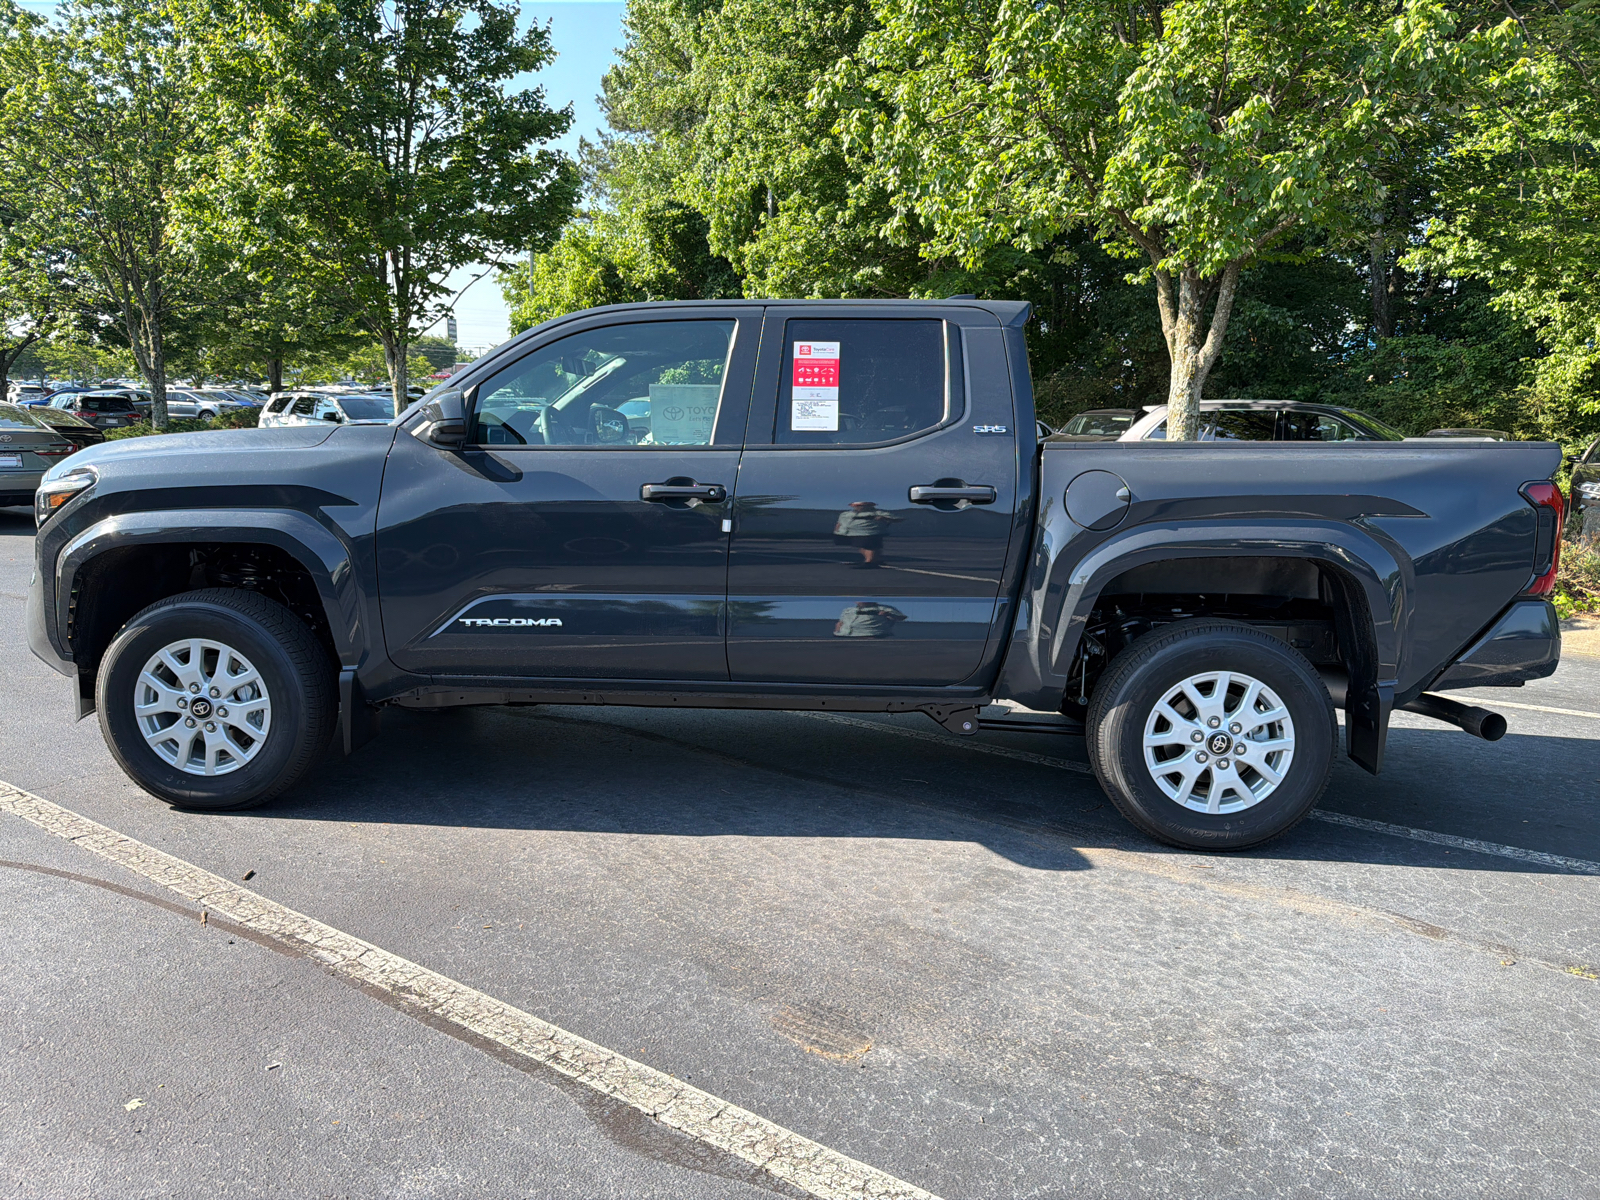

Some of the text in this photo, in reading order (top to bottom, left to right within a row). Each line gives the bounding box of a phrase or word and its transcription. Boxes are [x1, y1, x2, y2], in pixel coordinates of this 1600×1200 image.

[686, 406, 715, 415] TOYO
[973, 425, 1006, 433] SR5
[459, 618, 562, 627] TACOMA
